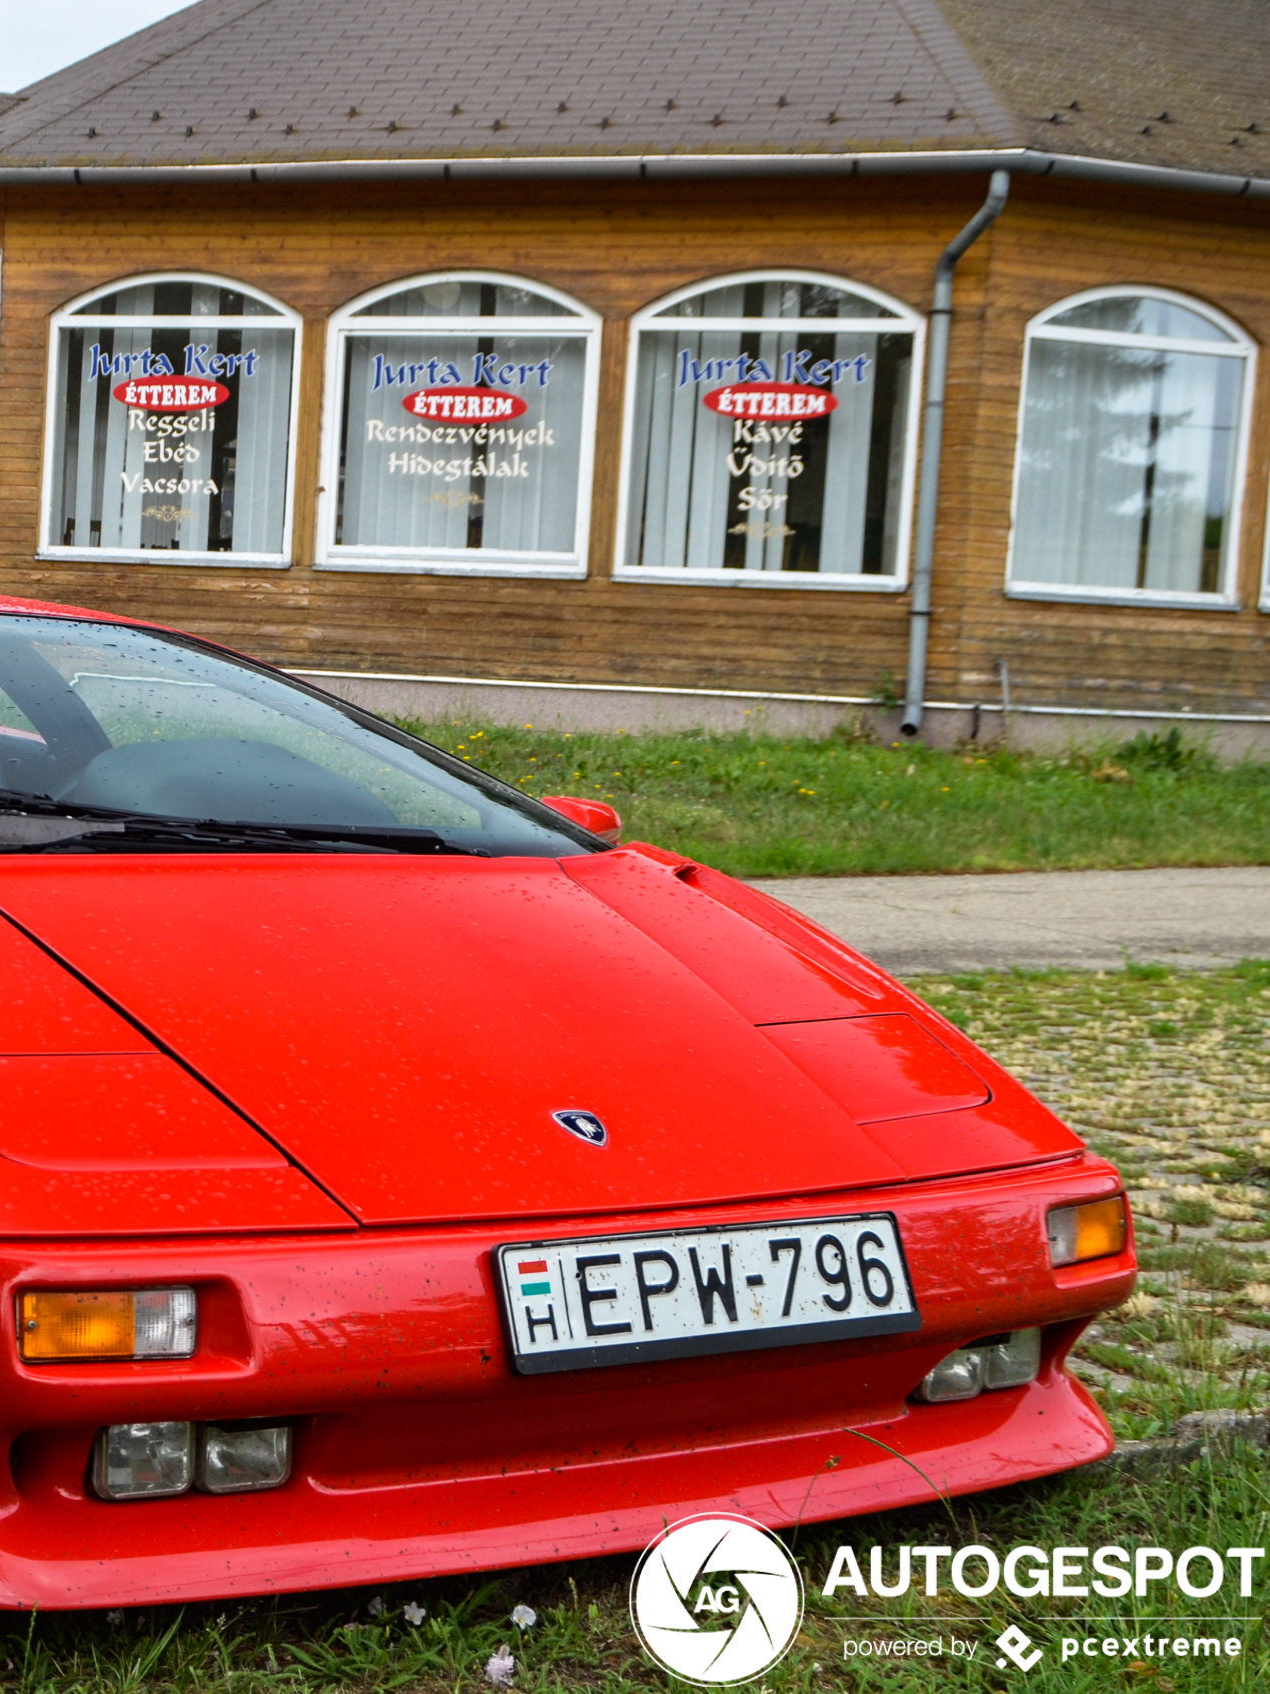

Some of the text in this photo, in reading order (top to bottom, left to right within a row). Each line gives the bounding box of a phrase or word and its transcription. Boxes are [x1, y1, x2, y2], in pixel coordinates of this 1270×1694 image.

[88, 343, 260, 381] Jurta Kert
[371, 352, 554, 393] Jurta Kert
[677, 348, 873, 389] Jurta Kert
[124, 382, 217, 406] ÉTTEREM
[413, 390, 514, 418] ÉTTEREM
[717, 388, 827, 416] ÉTTEREM
[128, 408, 216, 438] Reggeli
[366, 419, 555, 450] Rendezvények
[733, 419, 804, 444] Kávé
[142, 439, 200, 463] Ebéd
[388, 452, 530, 482] Hidegtálak
[120, 472, 219, 495] Vacsora
[737, 486, 788, 510] Sör
[576, 1231, 894, 1337] EPW-796
[525, 1304, 558, 1343] H
